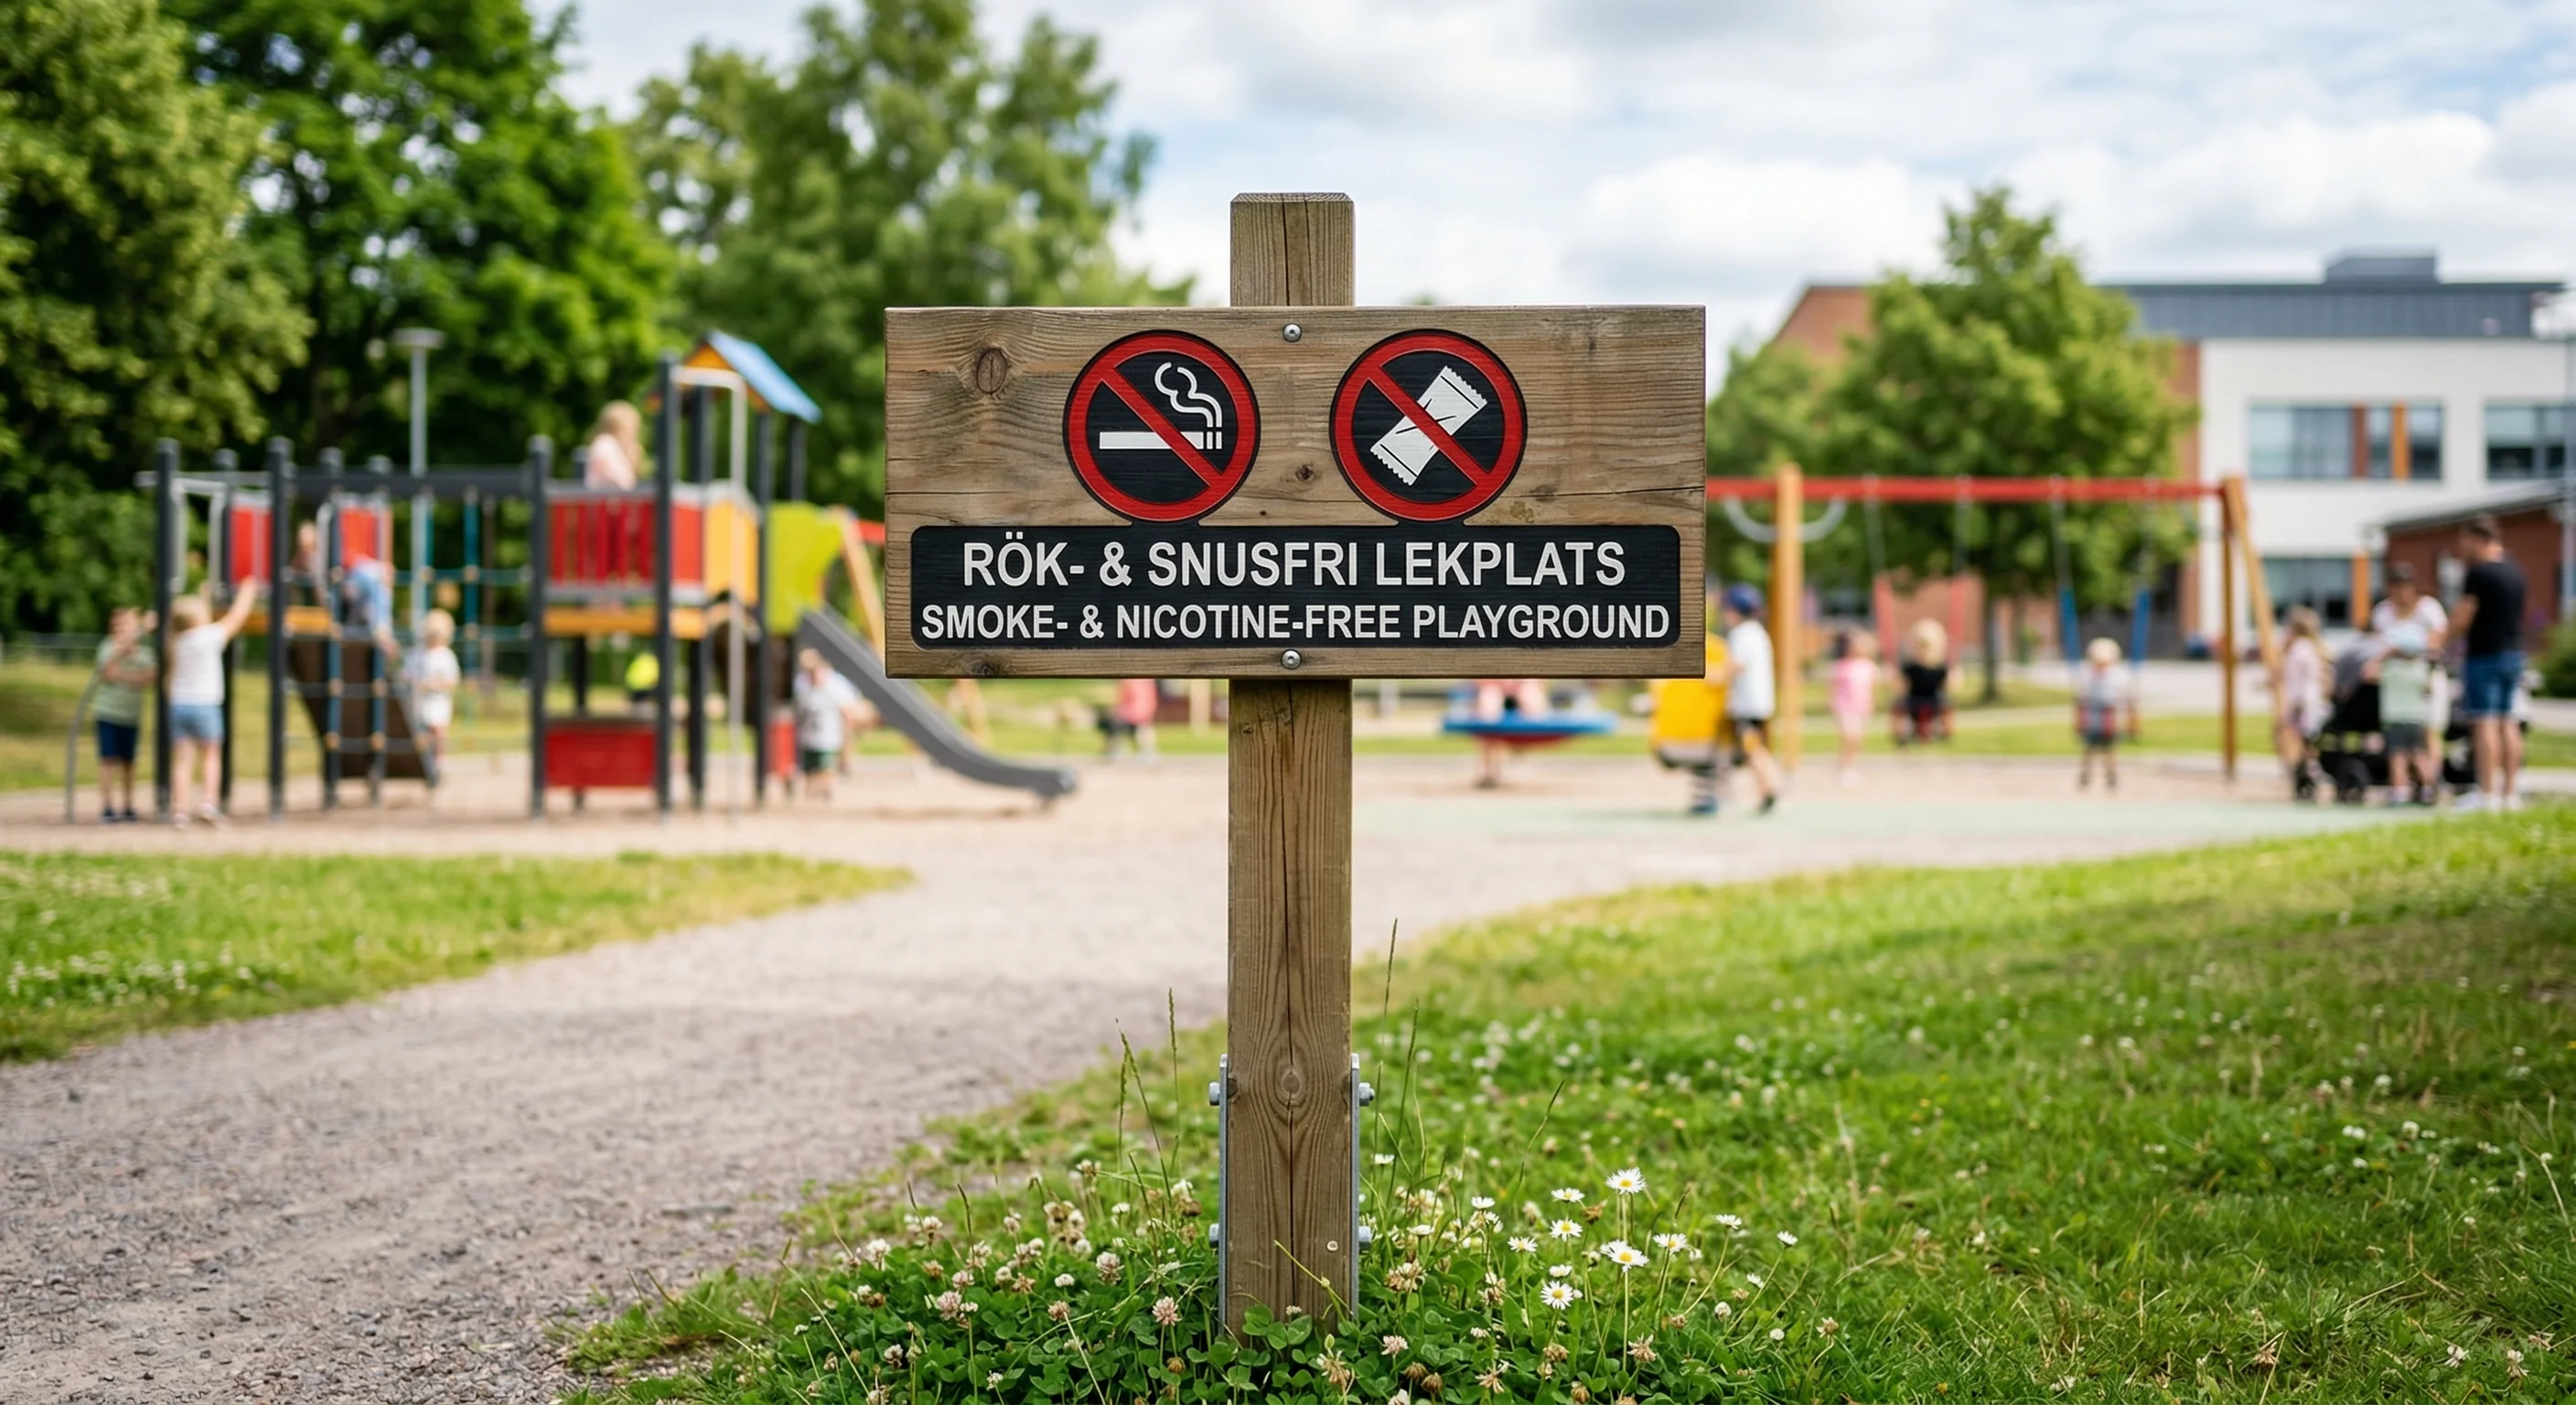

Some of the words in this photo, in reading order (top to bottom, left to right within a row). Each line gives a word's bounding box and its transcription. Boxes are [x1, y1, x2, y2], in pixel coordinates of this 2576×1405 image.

[963, 531, 1085, 587] RÖK-
[1099, 541, 1132, 587] &
[1147, 541, 1358, 587] SNUSFRI
[1376, 541, 1626, 586] LEKPLATS
[921, 604, 1068, 639] SMOKE-
[1079, 604, 1105, 639] &
[1117, 604, 1401, 638] NICOTINE-FREE
[1413, 604, 1669, 638] PLAYGROUND
